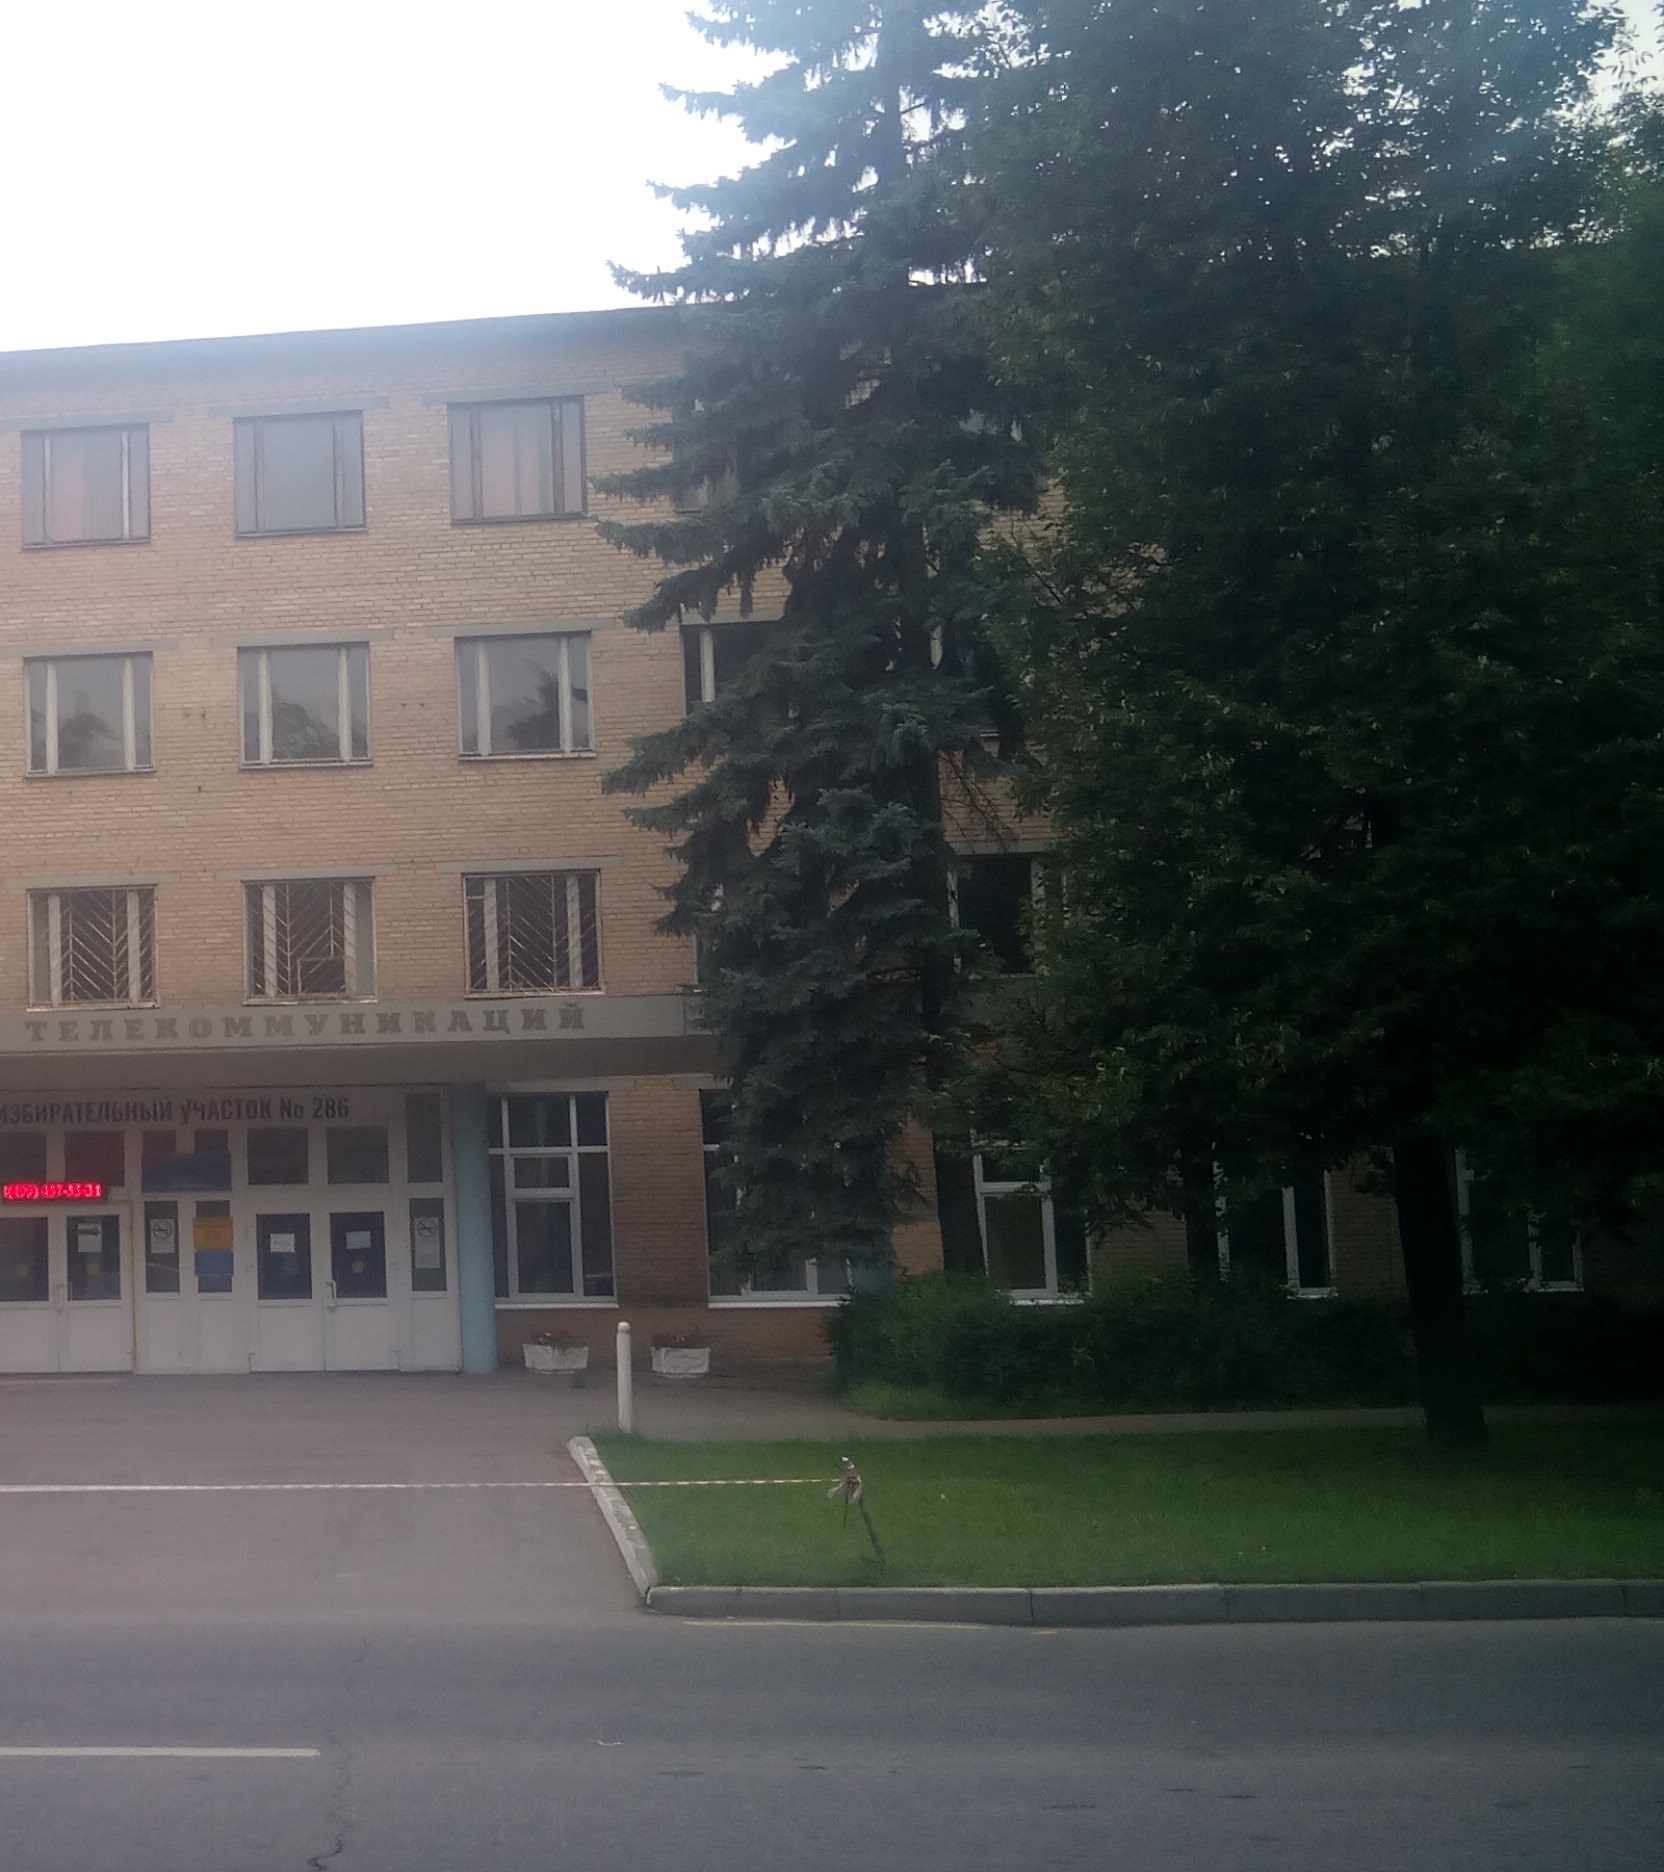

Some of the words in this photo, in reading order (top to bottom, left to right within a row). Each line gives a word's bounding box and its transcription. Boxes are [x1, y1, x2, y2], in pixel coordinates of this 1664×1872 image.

[25, 1003, 586, 1043] ТЕЛЕКОММУНИКАЦИЙ
[180, 1097, 273, 1126] УЧАСТОК
[312, 1096, 351, 1119] 286
